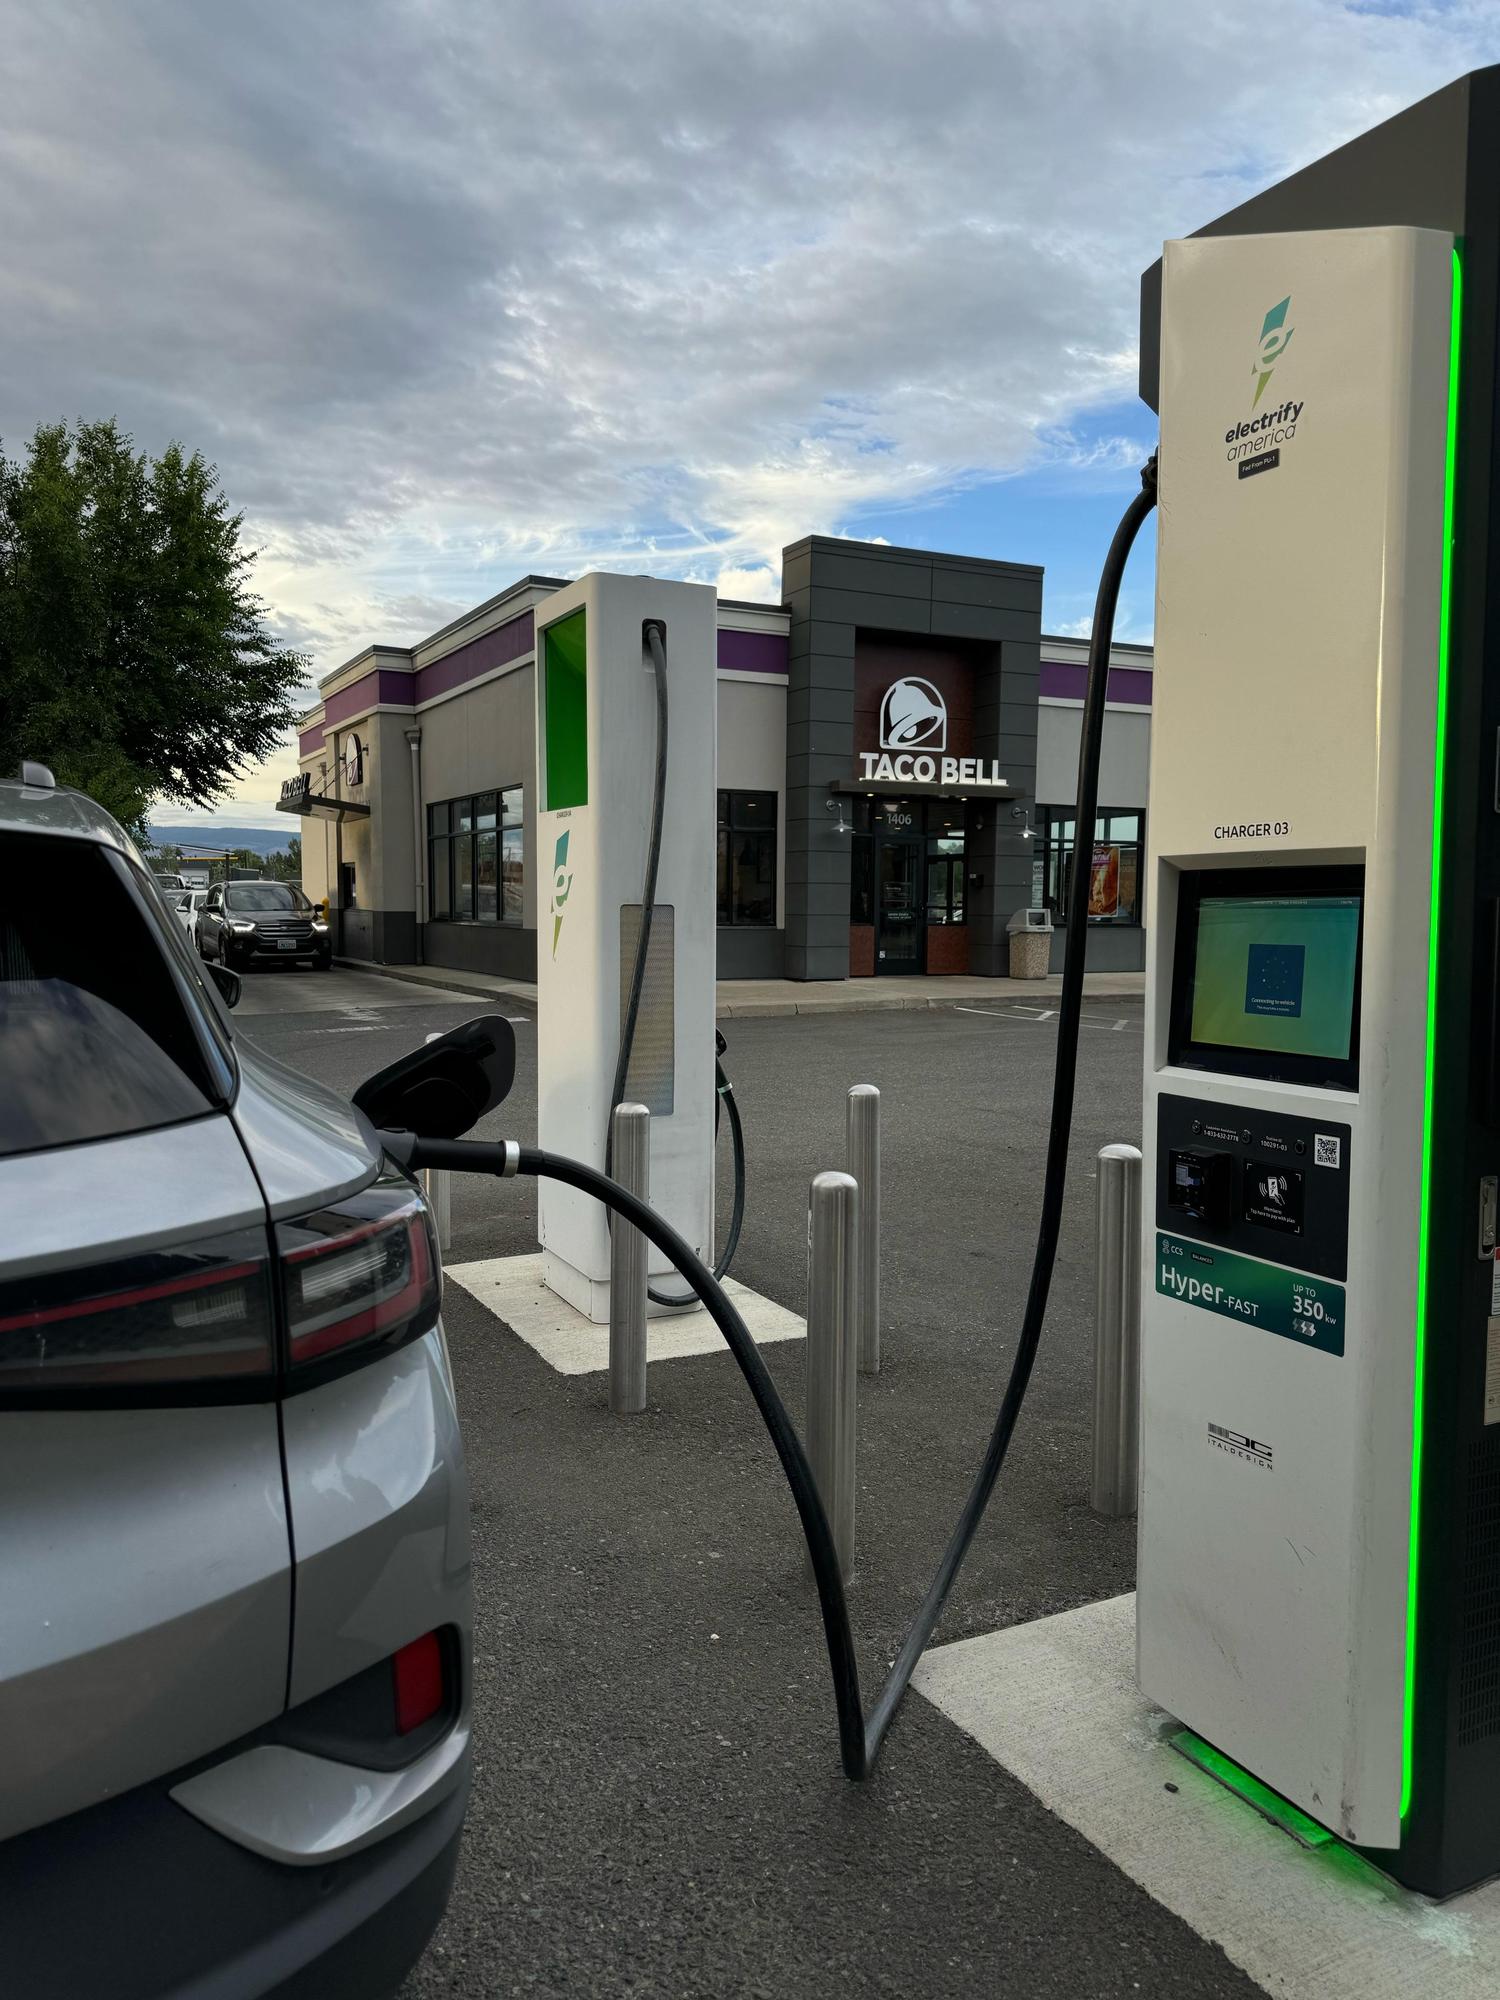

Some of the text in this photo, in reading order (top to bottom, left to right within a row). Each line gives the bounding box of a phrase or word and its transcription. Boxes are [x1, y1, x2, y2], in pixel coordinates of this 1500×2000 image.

[1225, 401, 1304, 443] electrify
[1227, 424, 1296, 461] america
[859, 752, 1008, 785] TACO BELL
[887, 813, 912, 825] 1406
[1214, 821, 1289, 839] CHARGER 03
[1170, 1245, 1184, 1256] CCS
[1292, 1283, 1316, 1297] UP TO
[1292, 1295, 1324, 1320] 350
[1208, 1438, 1273, 1470] ITALDESIGN
